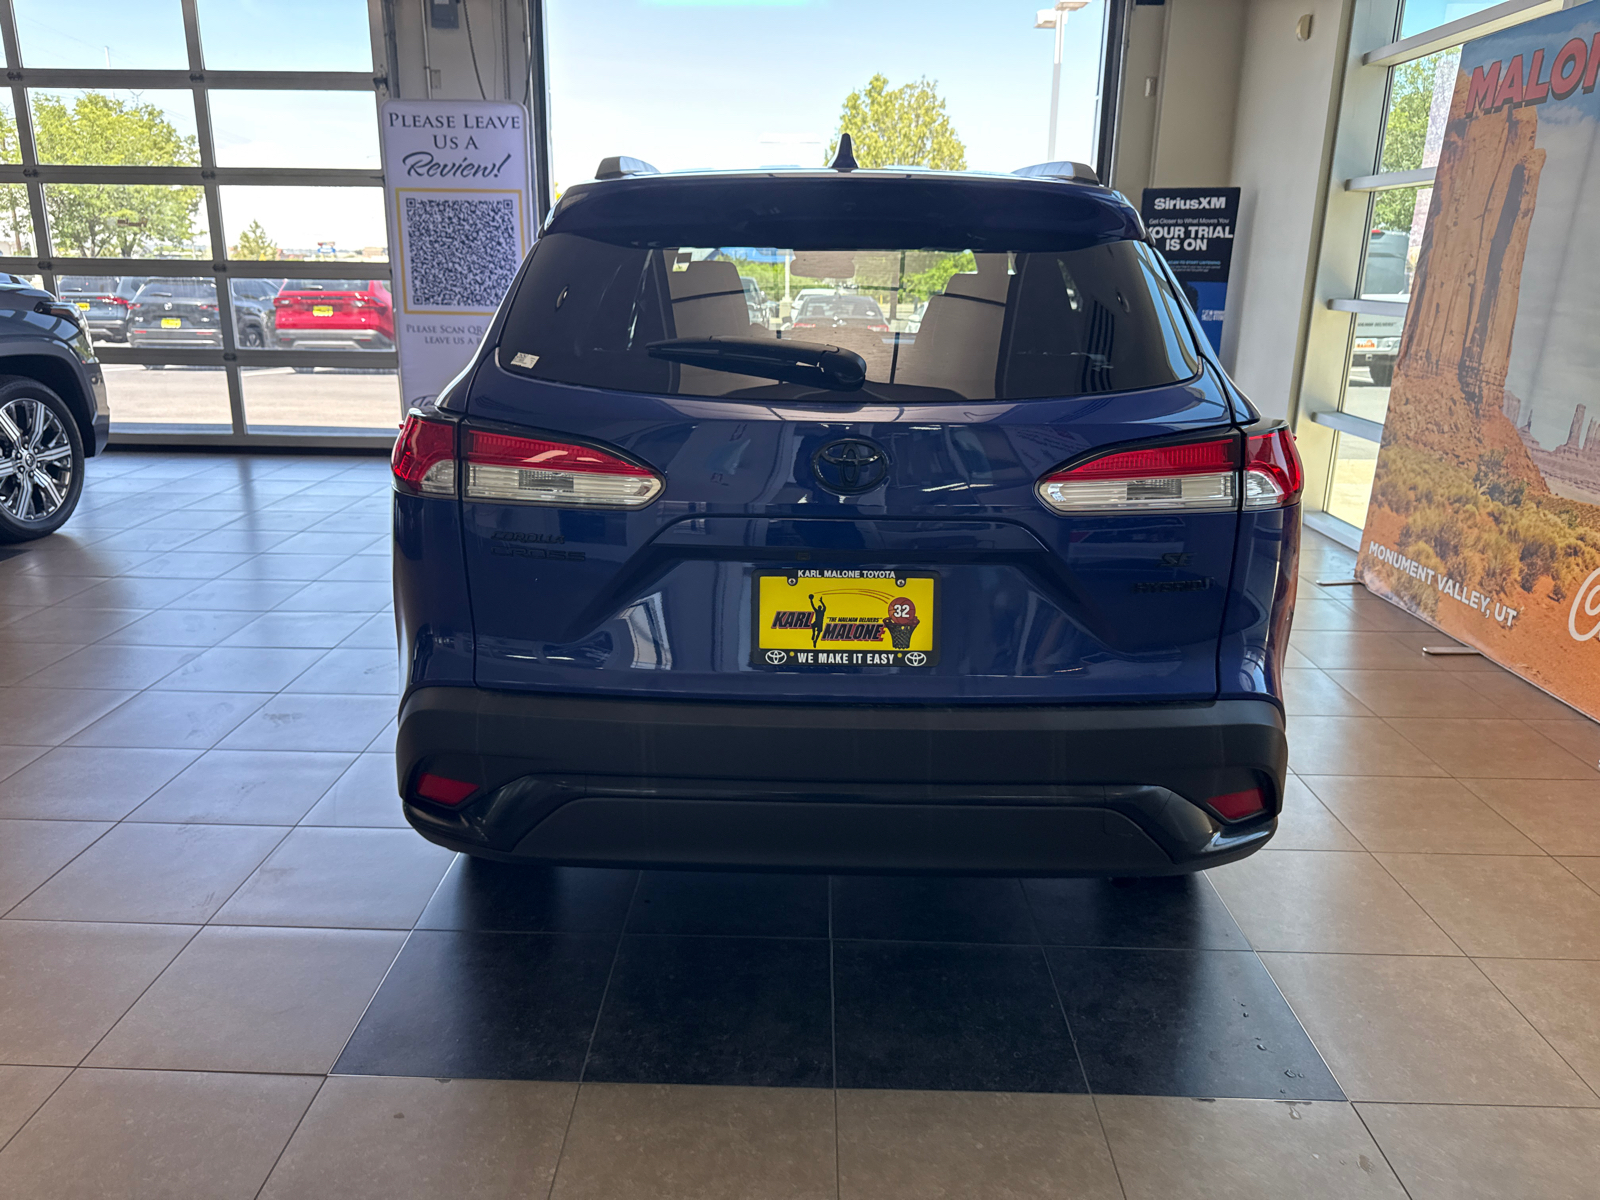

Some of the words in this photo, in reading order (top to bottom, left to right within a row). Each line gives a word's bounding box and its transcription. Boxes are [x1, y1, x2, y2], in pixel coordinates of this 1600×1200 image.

[388, 112, 456, 129] PLEASE
[463, 113, 521, 130] LEAVE
[432, 134, 459, 150] US
[465, 135, 480, 150] A
[402, 151, 512, 178] Review!
[1154, 197, 1226, 210] SiriusXM
[1188, 226, 1233, 239] TRIAL
[1165, 239, 1181, 251] IS
[1183, 238, 1208, 251] ON
[405, 323, 437, 334] PLEASE
[440, 324, 466, 335] SCAN
[467, 325, 483, 336] QR
[424, 336, 450, 345] LEAVE
[452, 336, 465, 345] US
[467, 337, 474, 345] A
[490, 531, 565, 545] COROLLA
[490, 546, 586, 561] CROSS
[797, 569, 822, 578] KARL
[823, 570, 860, 578] MALONE
[862, 571, 896, 579] TOYOTA
[1369, 540, 1435, 586] MONUMENT
[1437, 573, 1491, 618] VALLEY,
[1494, 602, 1518, 627] UT
[893, 604, 910, 618] 32
[771, 611, 815, 629] KARL
[821, 623, 885, 641] MALONE
[797, 652, 814, 663] WE
[818, 652, 849, 664] MAKE
[853, 652, 863, 664] IT
[866, 653, 894, 664] EASY
